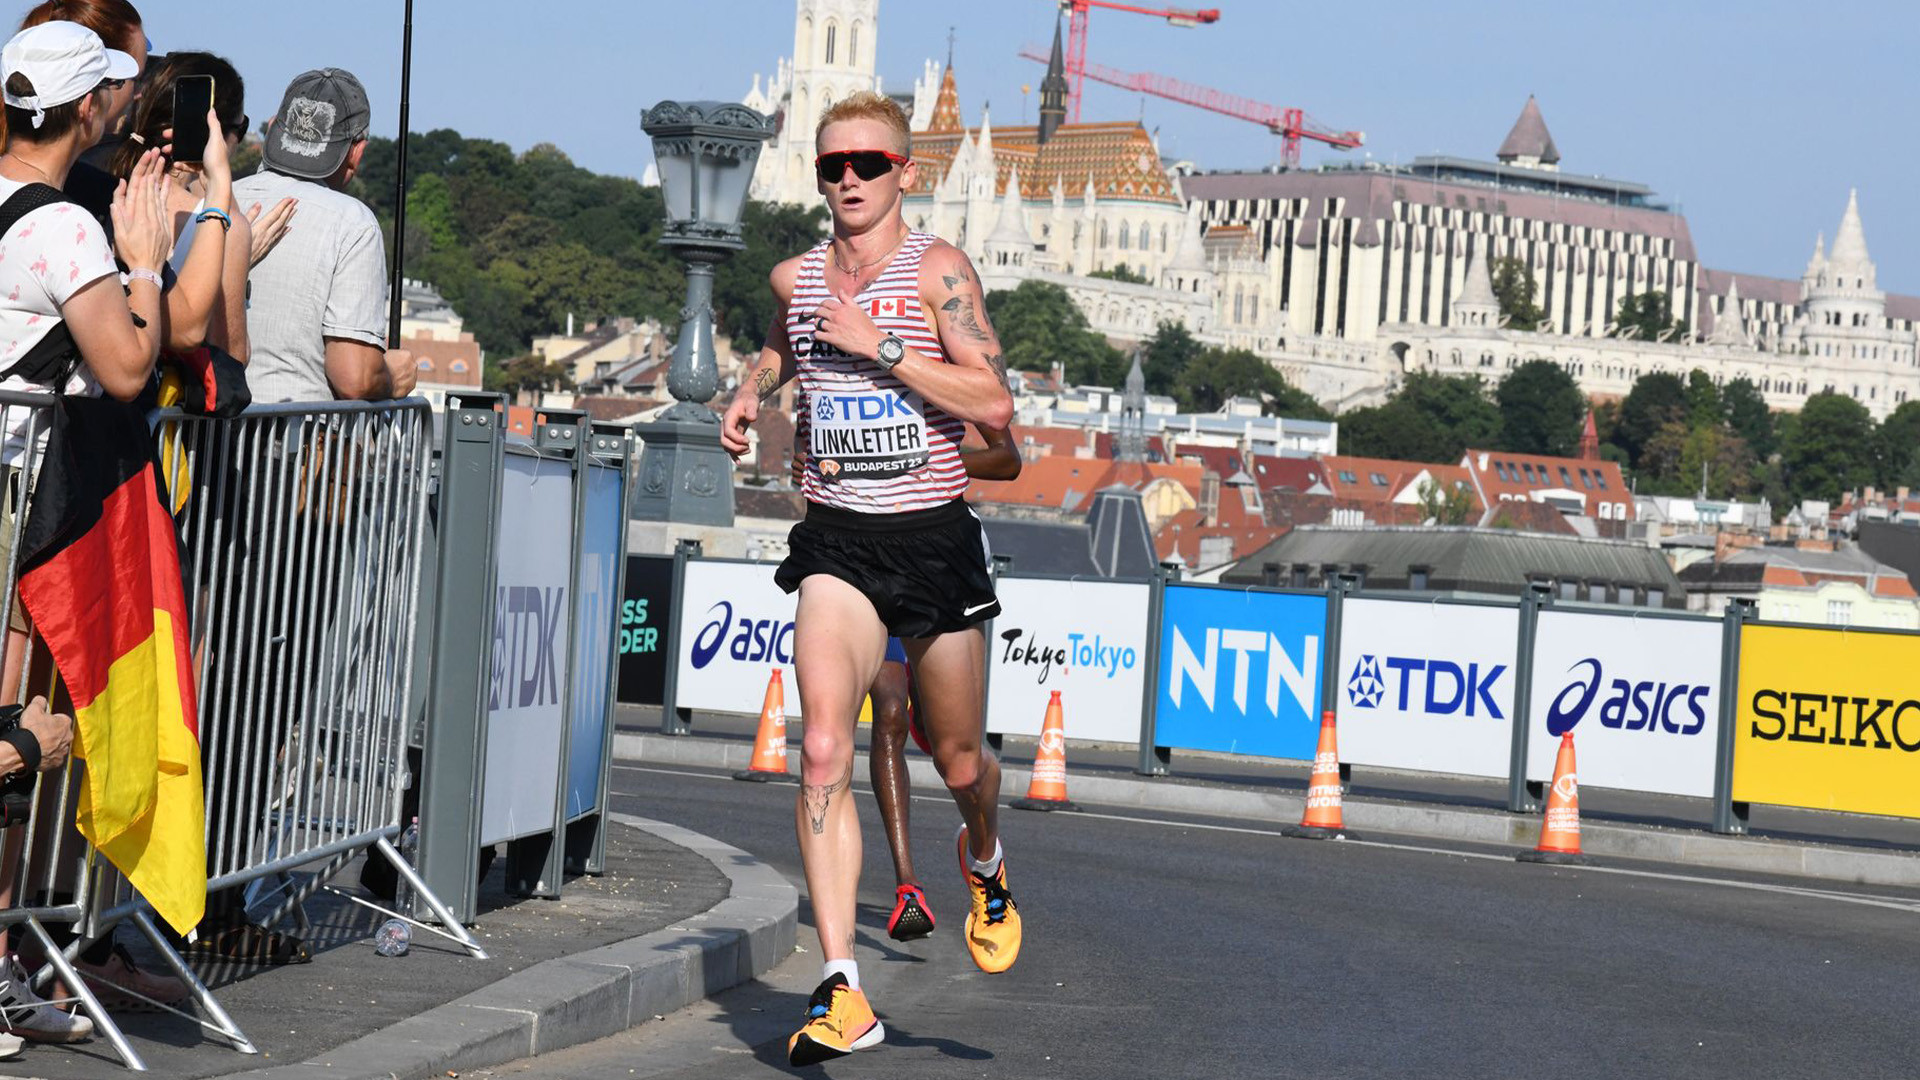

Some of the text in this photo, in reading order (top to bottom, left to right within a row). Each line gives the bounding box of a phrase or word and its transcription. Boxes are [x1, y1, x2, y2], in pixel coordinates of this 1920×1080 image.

[834, 391, 914, 420] TDK
[815, 423, 921, 454] LINKLETTER
[844, 460, 907, 472] BUDAPEST
[622, 598, 649, 625] SS
[508, 586, 564, 709] TDK
[620, 627, 658, 654] DER
[730, 618, 796, 664] asic
[1001, 627, 1136, 685] Tokyo Tokyo
[1169, 623, 1319, 722] NTN
[1386, 656, 1508, 720] TDK
[1751, 689, 1920, 753] SEIKO
